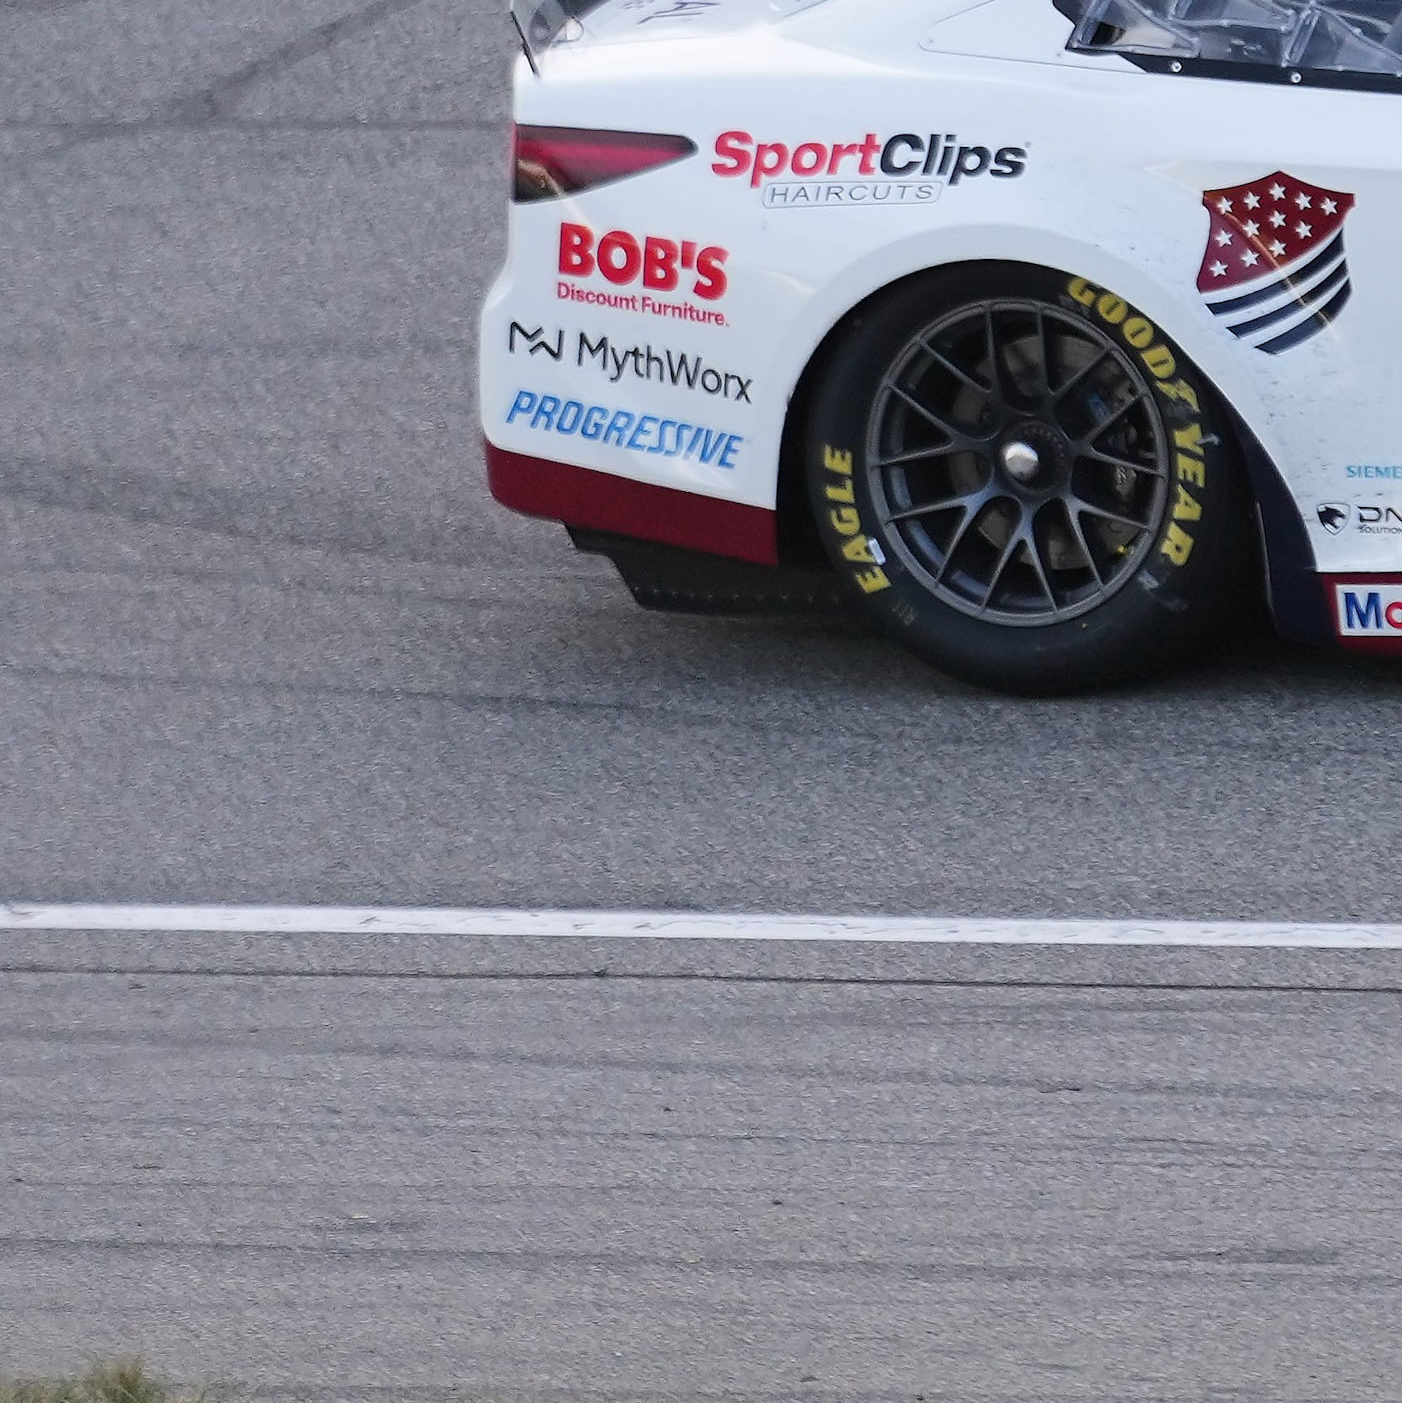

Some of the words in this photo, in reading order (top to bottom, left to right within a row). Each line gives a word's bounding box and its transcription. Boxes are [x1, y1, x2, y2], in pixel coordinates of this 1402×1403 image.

[711, 130, 1028, 189] SportClips
[769, 184, 934, 204] HAIRCUTS
[556, 282, 638, 312] Discount
[558, 221, 730, 301] BOB'S
[577, 330, 753, 405] MythWorx
[505, 390, 745, 469] PROGRESSIVE
[1067, 277, 1206, 567] GOODYEAR
[823, 444, 891, 594] EAGLE
